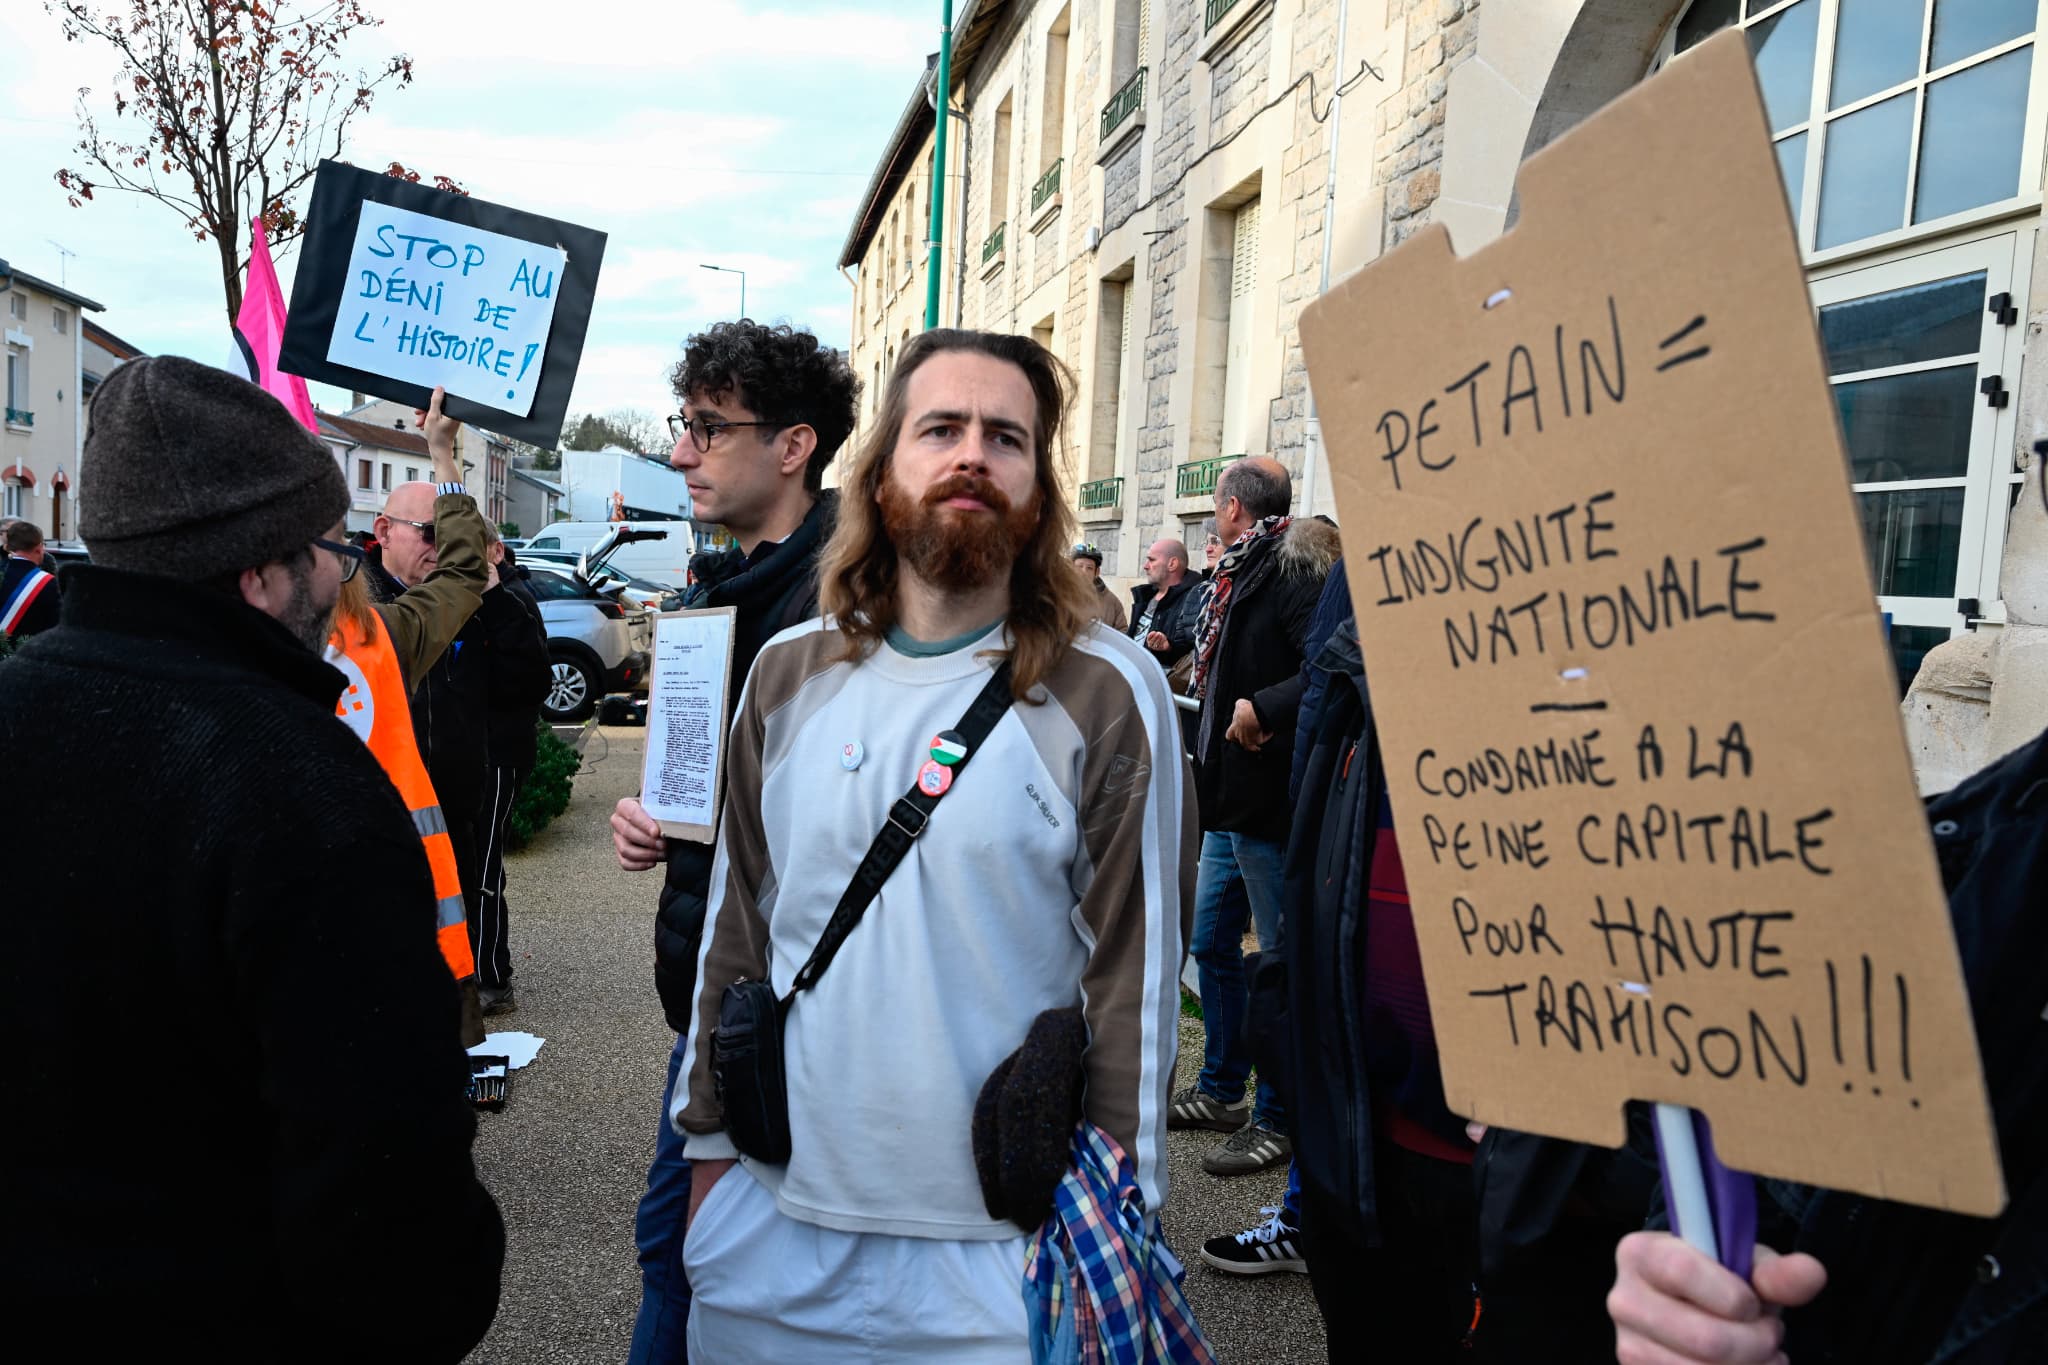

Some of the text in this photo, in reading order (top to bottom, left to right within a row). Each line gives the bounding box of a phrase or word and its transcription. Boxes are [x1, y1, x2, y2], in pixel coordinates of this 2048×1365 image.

[368, 225, 553, 298] STOP AU
[474, 298, 517, 331] DE
[1376, 296, 1627, 491] PETAIN
[1368, 491, 1619, 607] INDIGNITE
[1443, 537, 1777, 669] NATIONALE
[1416, 722, 1752, 797] CONDAMNE A LA
[1423, 803, 1834, 875] PEINE CAPITALE
[1452, 896, 1795, 984] POUR HAUTE
